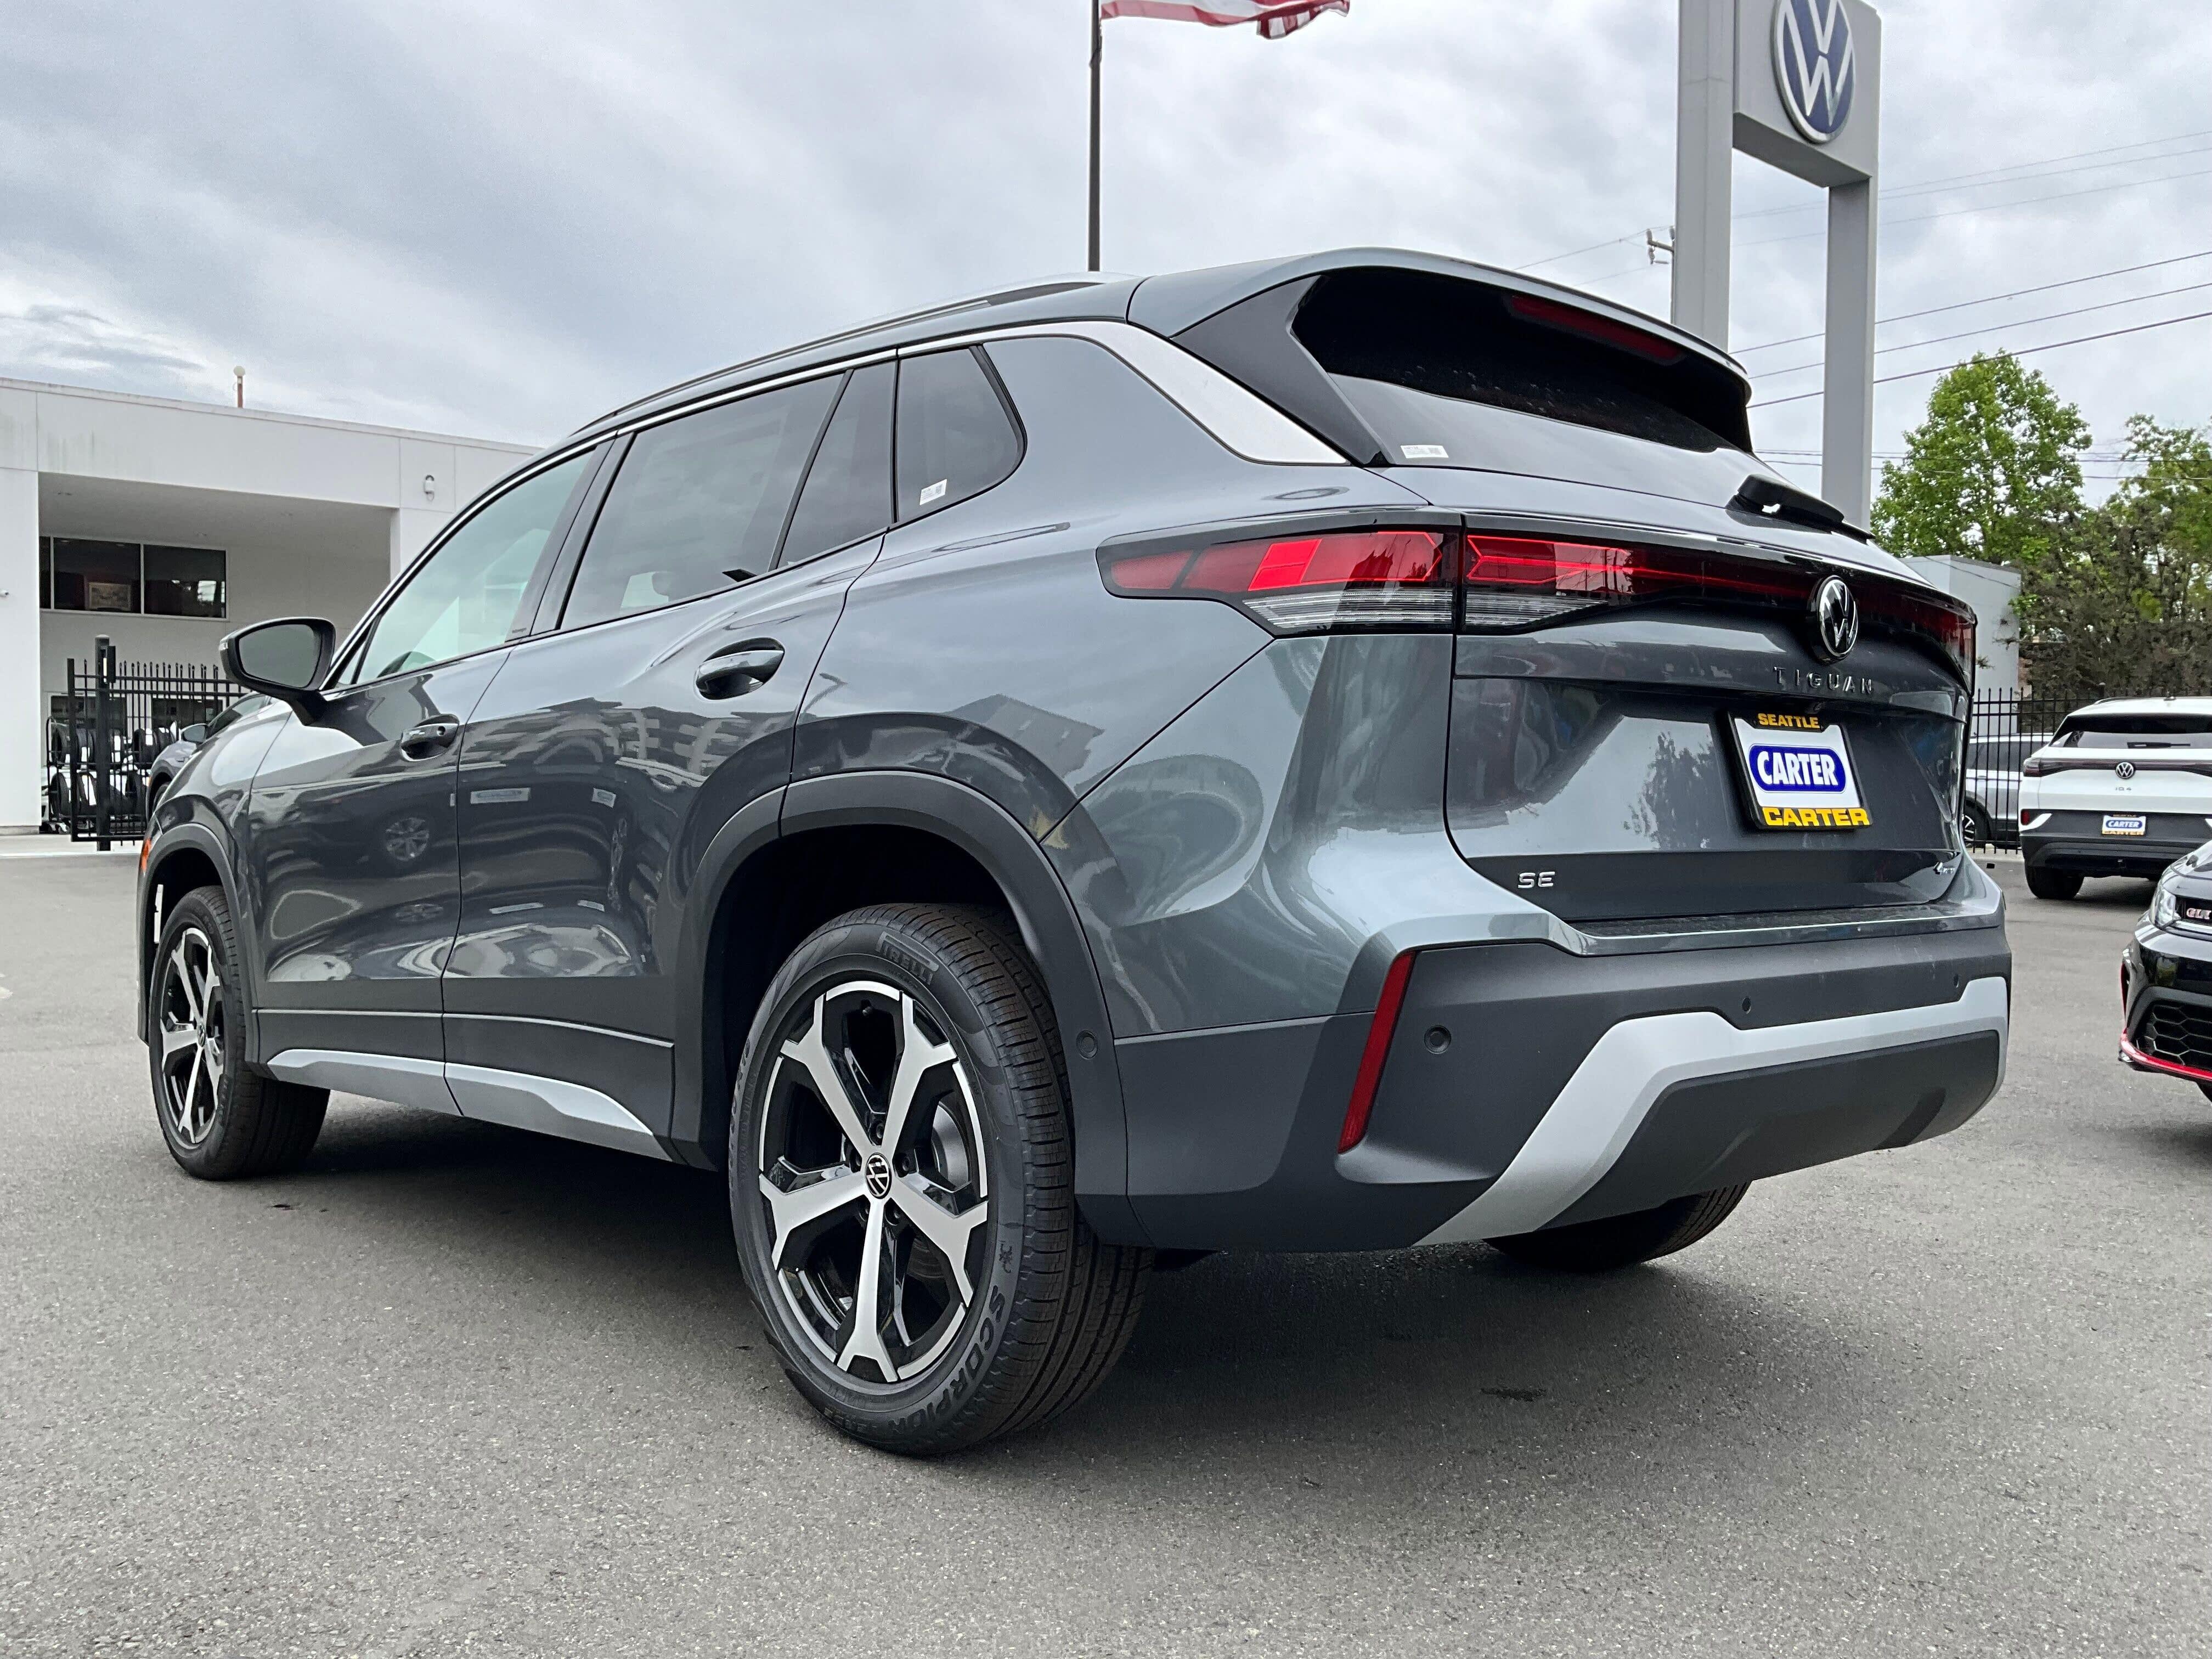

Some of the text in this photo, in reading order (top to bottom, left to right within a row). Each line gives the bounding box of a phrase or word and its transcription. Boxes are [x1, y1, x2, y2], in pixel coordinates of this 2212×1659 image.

[1773, 665, 1872, 695] TIGUAN
[1757, 713, 1820, 729] SEATTLE
[1757, 751, 1838, 786] CARTER
[1762, 807, 1871, 826] CARTER
[1517, 871, 1555, 888] SE
[874, 930, 939, 985] PIRELLI
[887, 1285, 1006, 1438] SCORPION
